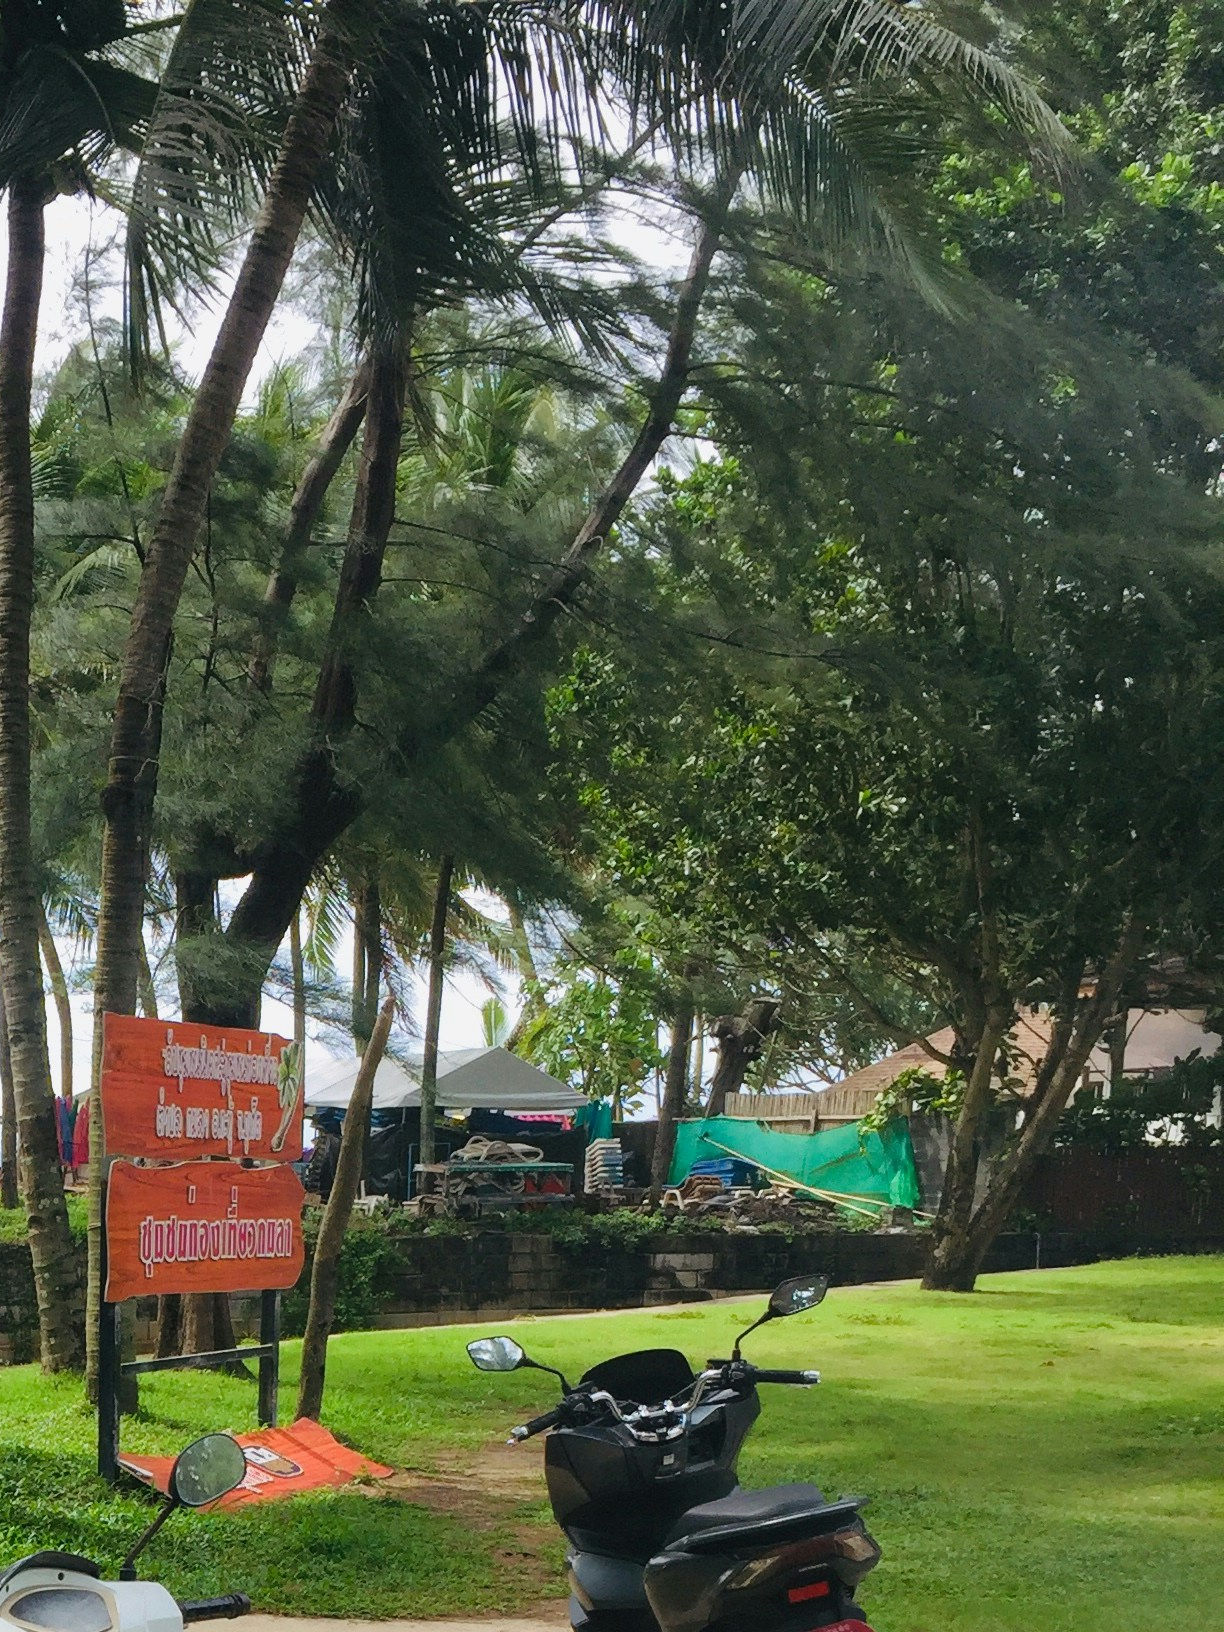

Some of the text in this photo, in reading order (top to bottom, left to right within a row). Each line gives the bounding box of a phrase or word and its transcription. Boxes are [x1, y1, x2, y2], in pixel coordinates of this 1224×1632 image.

[140, 1185, 293, 1278] ชุมชนท่องเที่ยวกมลา
